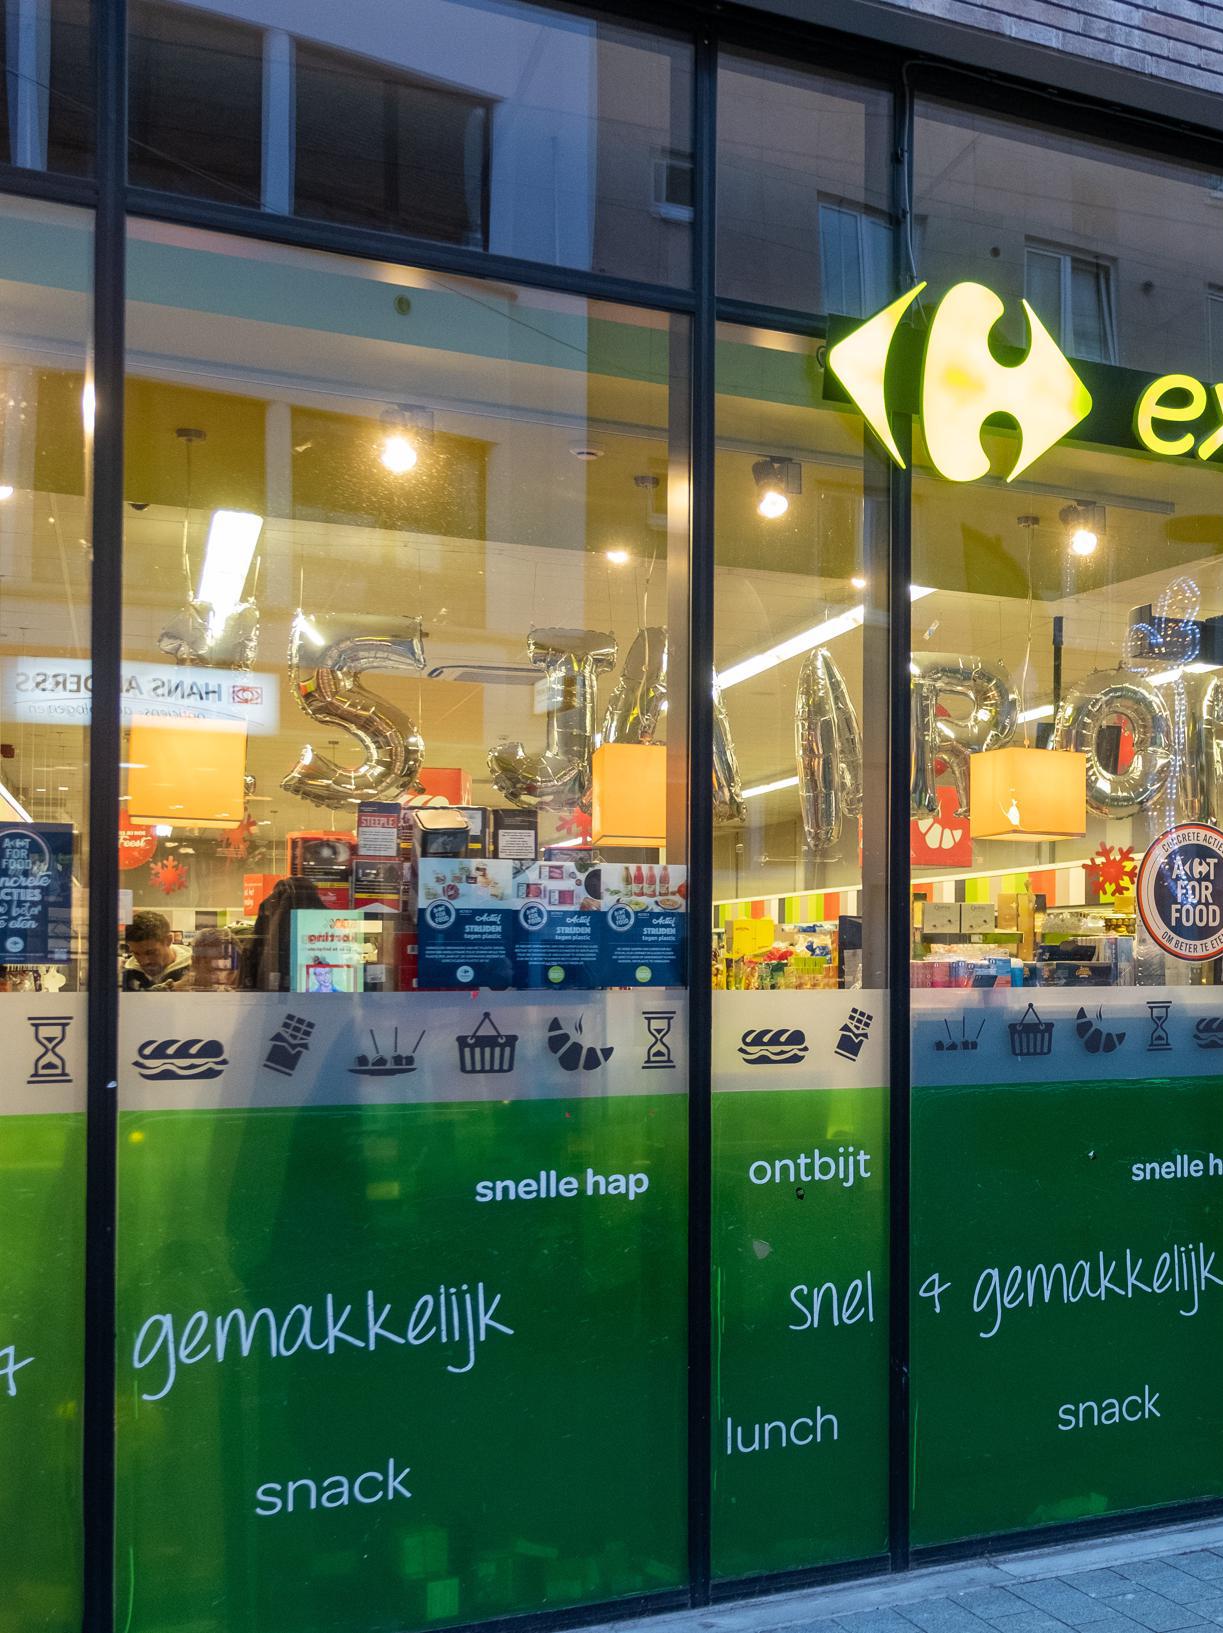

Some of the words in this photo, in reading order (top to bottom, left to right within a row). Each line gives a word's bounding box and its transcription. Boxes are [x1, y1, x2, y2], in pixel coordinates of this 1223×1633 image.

[361, 816, 395, 827] STEEPLE
[6, 849, 28, 859] FOR
[1161, 831, 1201, 853] CONCRETE
[2, 859, 32, 869] FOOD
[1177, 882, 1213, 903] FOR
[1171, 904, 1220, 927] FOOD
[1161, 931, 1175, 944] OM
[1174, 939, 1198, 953] BETER
[1199, 942, 1211, 953] TE
[749, 1146, 871, 1187] ontbijt
[1132, 1154, 1203, 1181] snelle
[475, 1169, 579, 1202] snelle
[587, 1167, 649, 1200] hap
[788, 1270, 875, 1330] snel
[973, 1242, 1223, 1338] gemakkelijk
[132, 1282, 514, 1401] gemakkelijk
[1058, 1384, 1161, 1431] snack
[727, 1405, 838, 1455] lunch
[255, 1458, 412, 1516] snack
